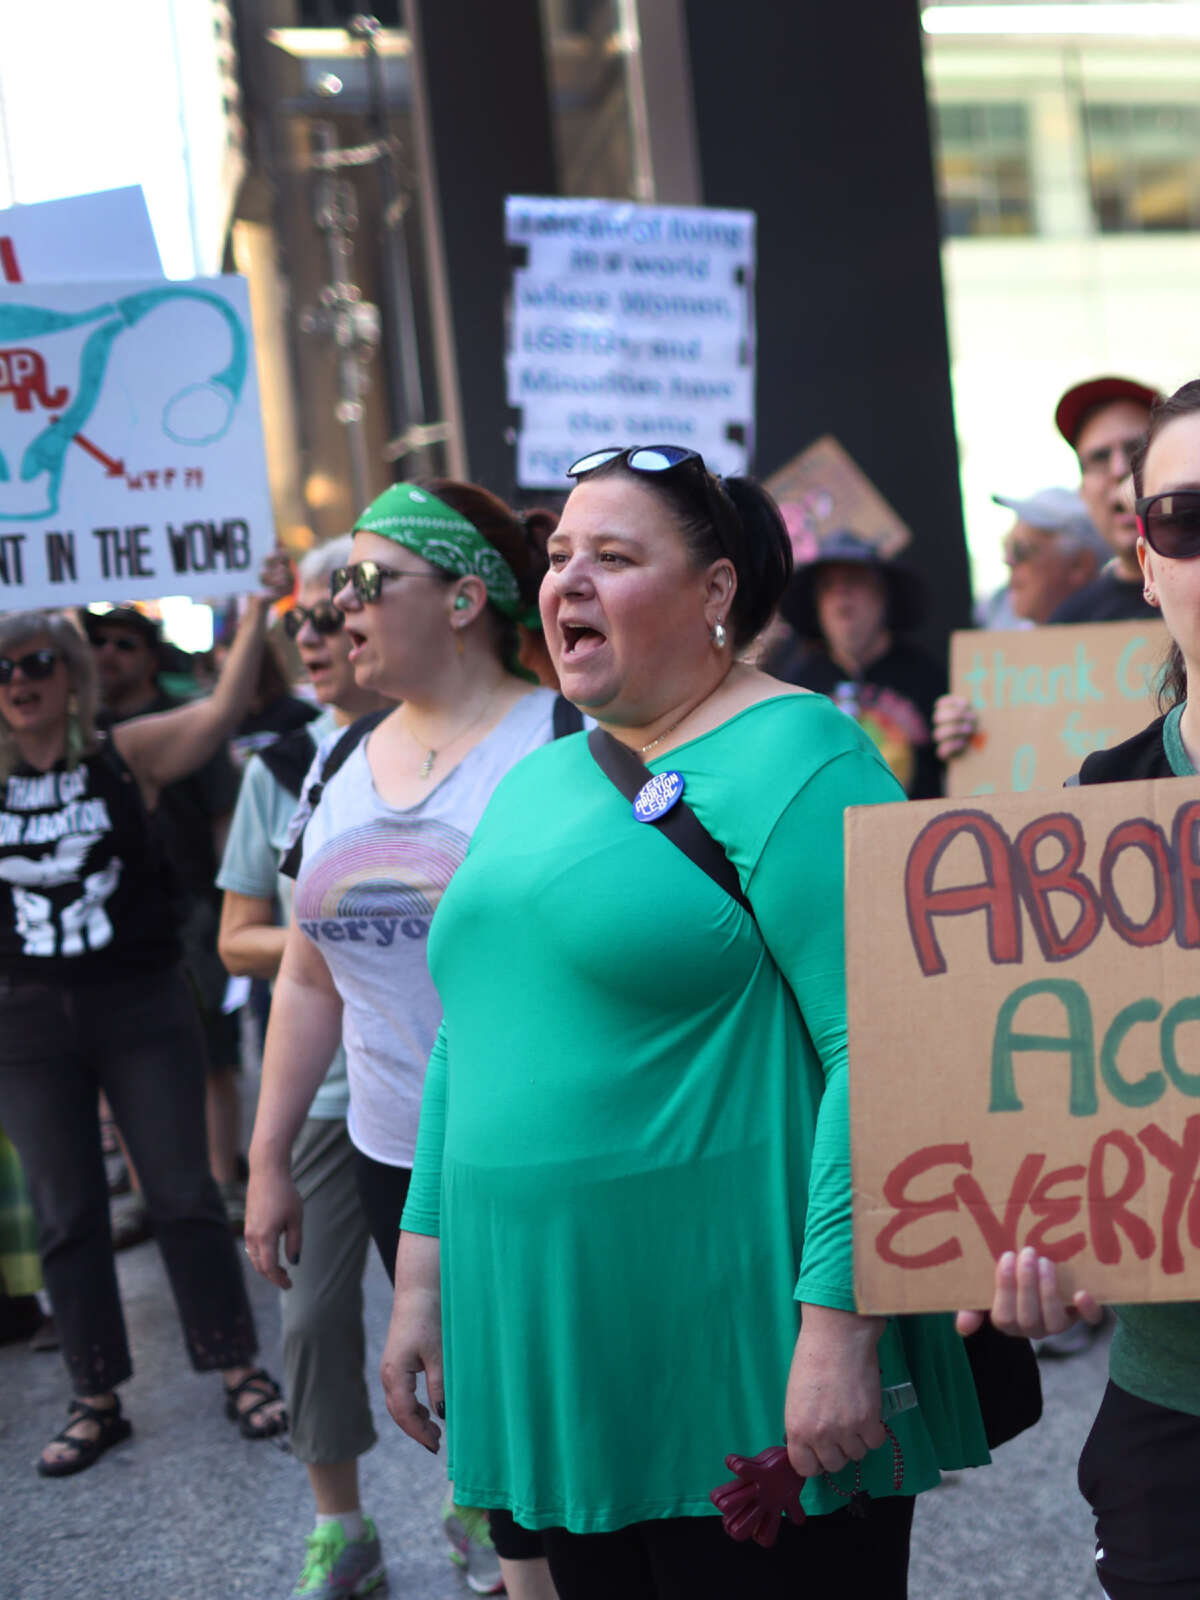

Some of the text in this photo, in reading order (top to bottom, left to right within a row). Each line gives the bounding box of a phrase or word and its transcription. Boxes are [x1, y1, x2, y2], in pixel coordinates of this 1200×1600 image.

[45, 530, 78, 584] IN
[93, 525, 155, 580] THE
[167, 518, 251, 575] WOMB
[963, 640, 1105, 710] thank
[301, 917, 430, 947] veryo
